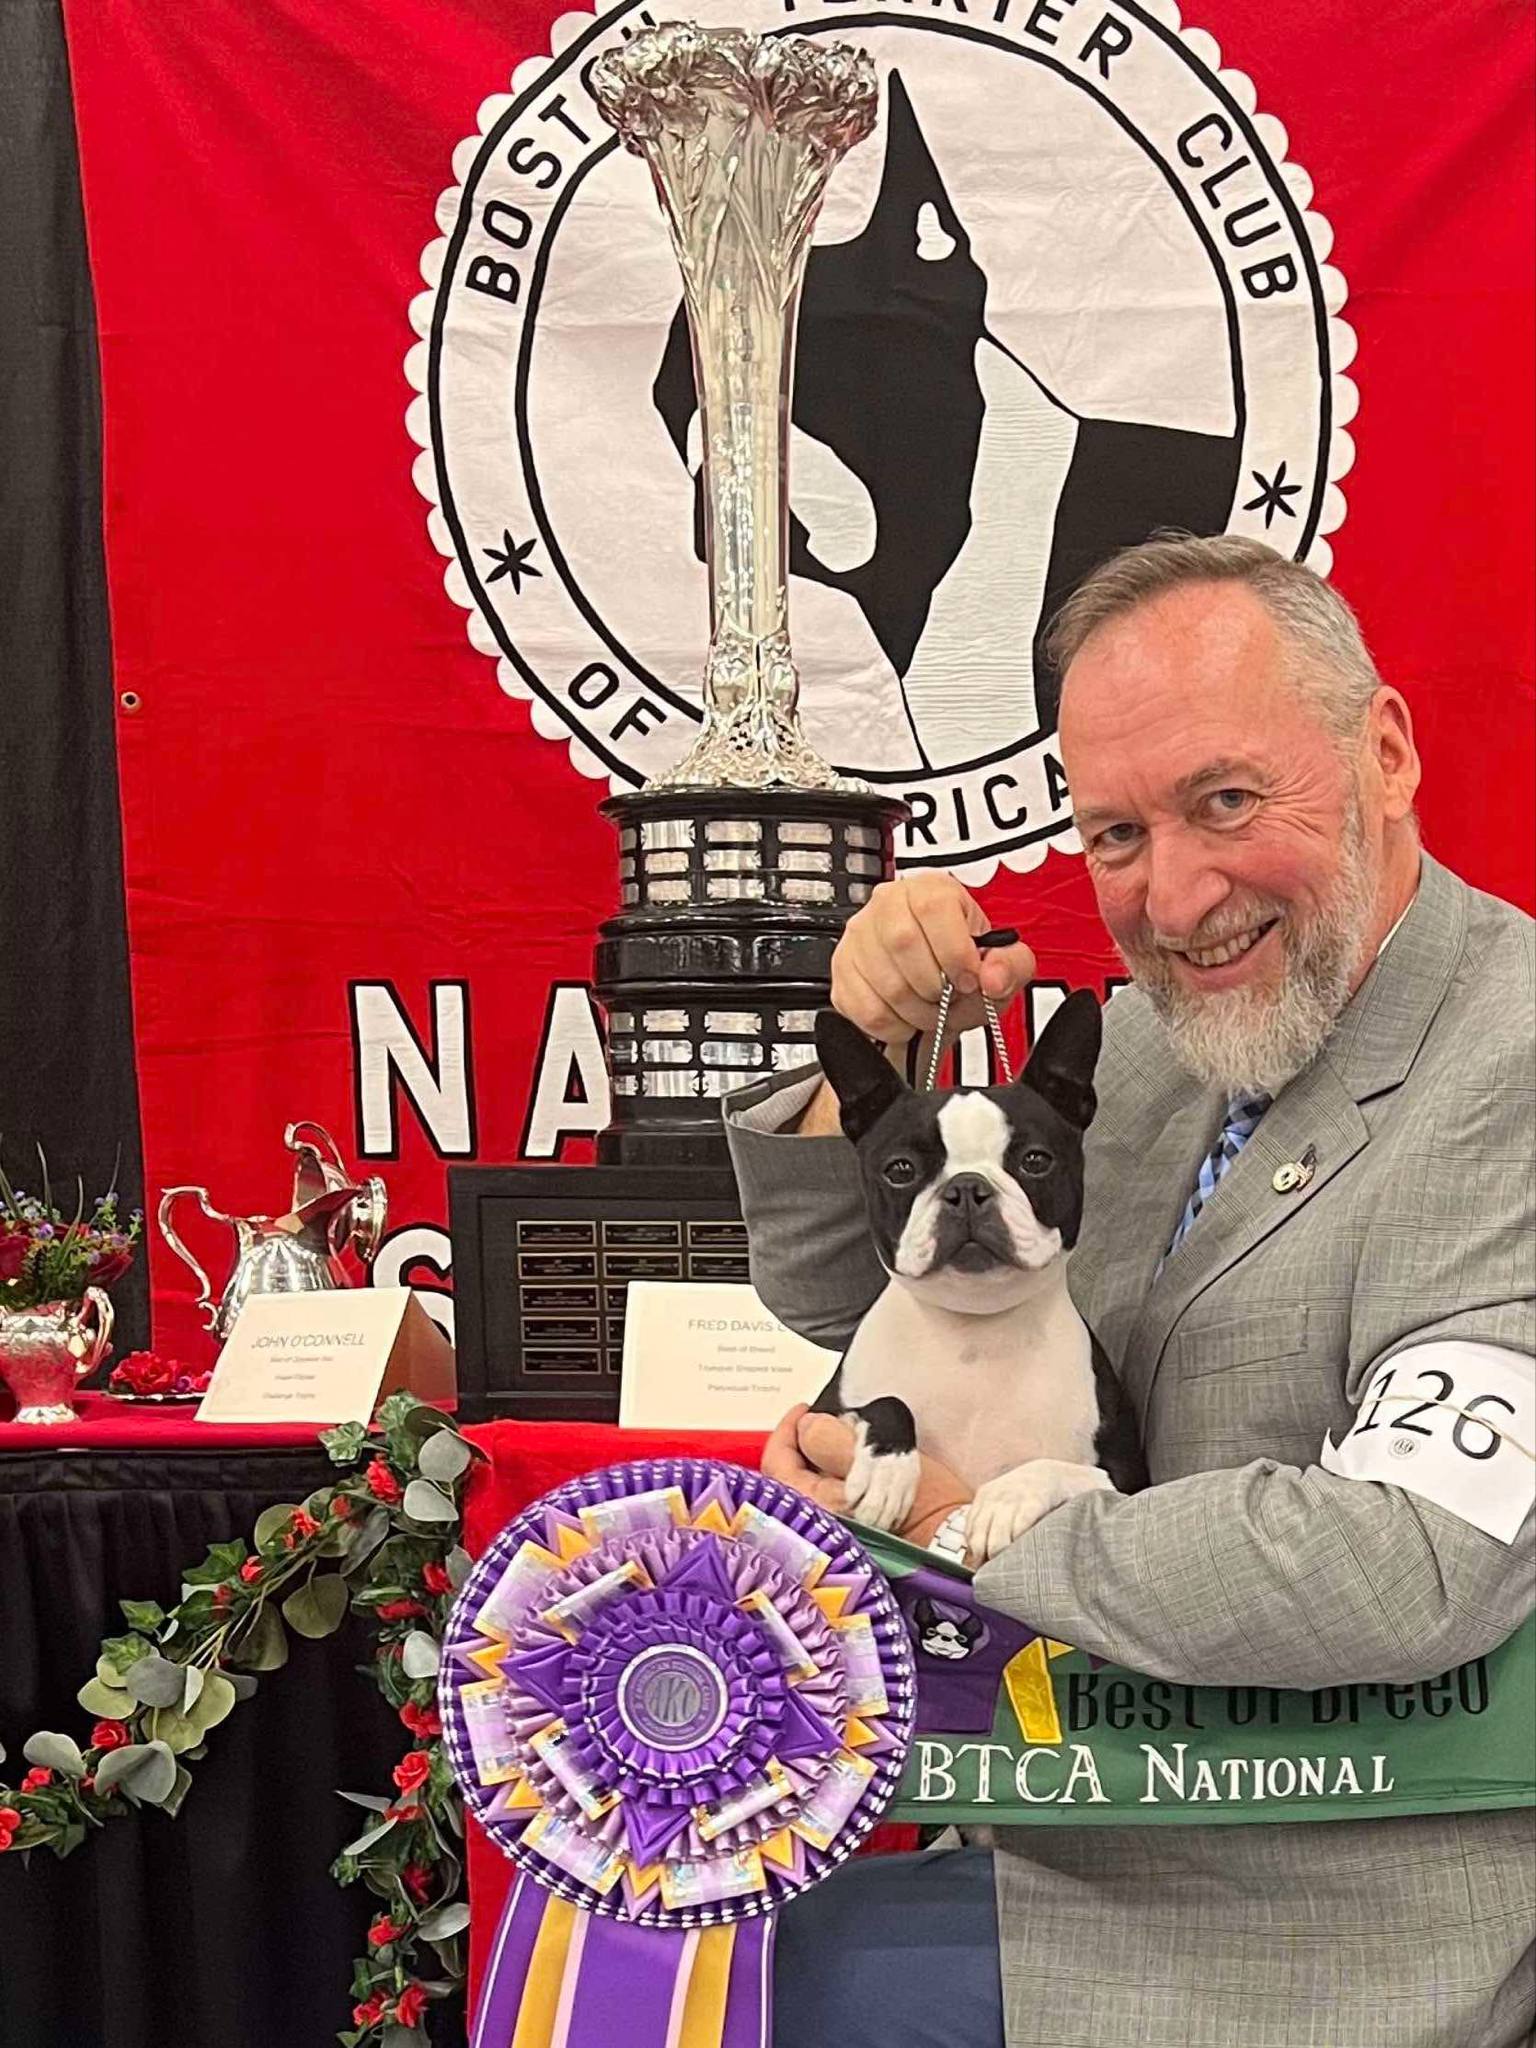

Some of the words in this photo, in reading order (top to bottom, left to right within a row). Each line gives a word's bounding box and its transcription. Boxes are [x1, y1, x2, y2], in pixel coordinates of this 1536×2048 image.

[465, 10, 657, 304] BOST
[1176, 112, 1298, 299] CLUB
[568, 662, 667, 741] OF
[903, 752, 1071, 847] RICA
[251, 1335, 287, 1349] JOHN
[290, 1333, 366, 1347] O'CONNELL
[688, 1319, 727, 1332] FRED
[730, 1320, 773, 1332] DAVIS
[1353, 1369, 1516, 1460] 126
[1069, 1673, 1205, 1731] Best
[911, 1741, 1112, 1804] BTCA
